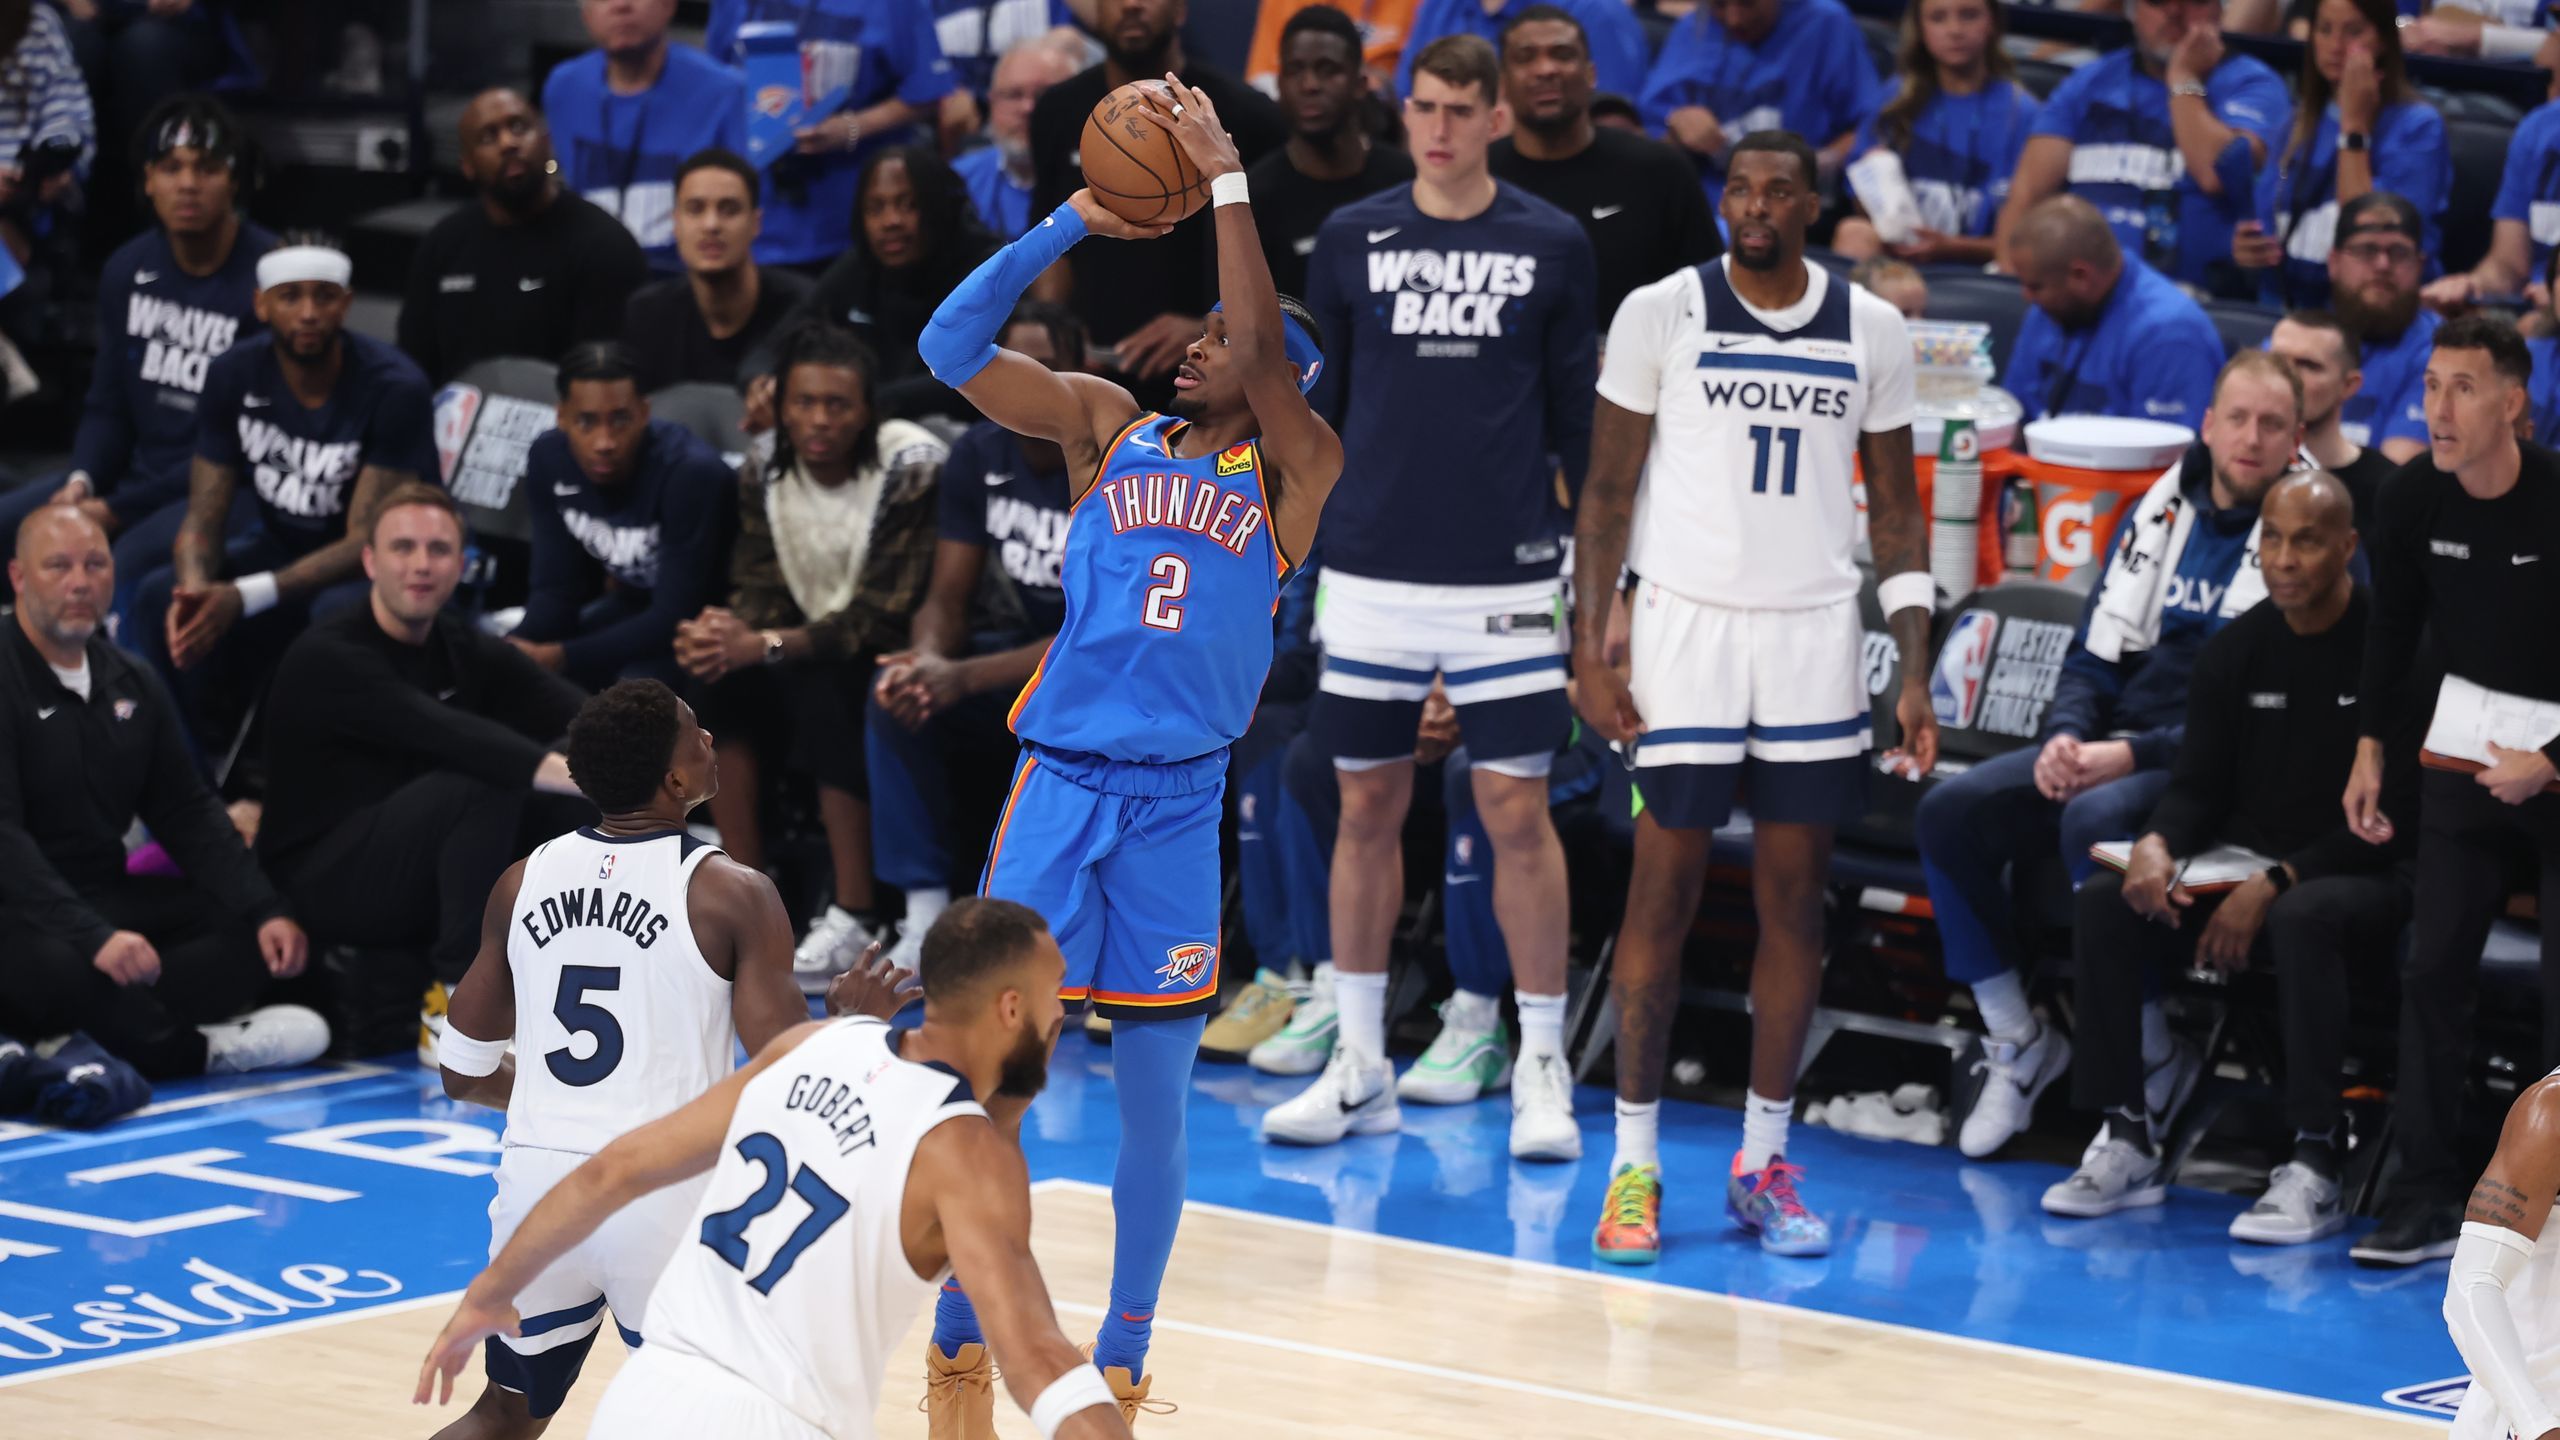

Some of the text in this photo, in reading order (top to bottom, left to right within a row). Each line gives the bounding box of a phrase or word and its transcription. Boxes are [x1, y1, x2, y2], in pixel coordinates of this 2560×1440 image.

[1367, 250, 1538, 296] WOLVES
[1391, 290, 1508, 337] BACK
[1703, 380, 1849, 419] WOLVES
[1749, 425, 1801, 495] 11
[1102, 473, 1265, 558] THUNDER
[2044, 502, 2094, 568] G
[1141, 552, 1190, 632] 2
[522, 887, 669, 950] EDWARDS
[544, 964, 624, 1088] 5
[786, 1074, 876, 1157] GOBERT
[700, 1131, 852, 1297] 27
